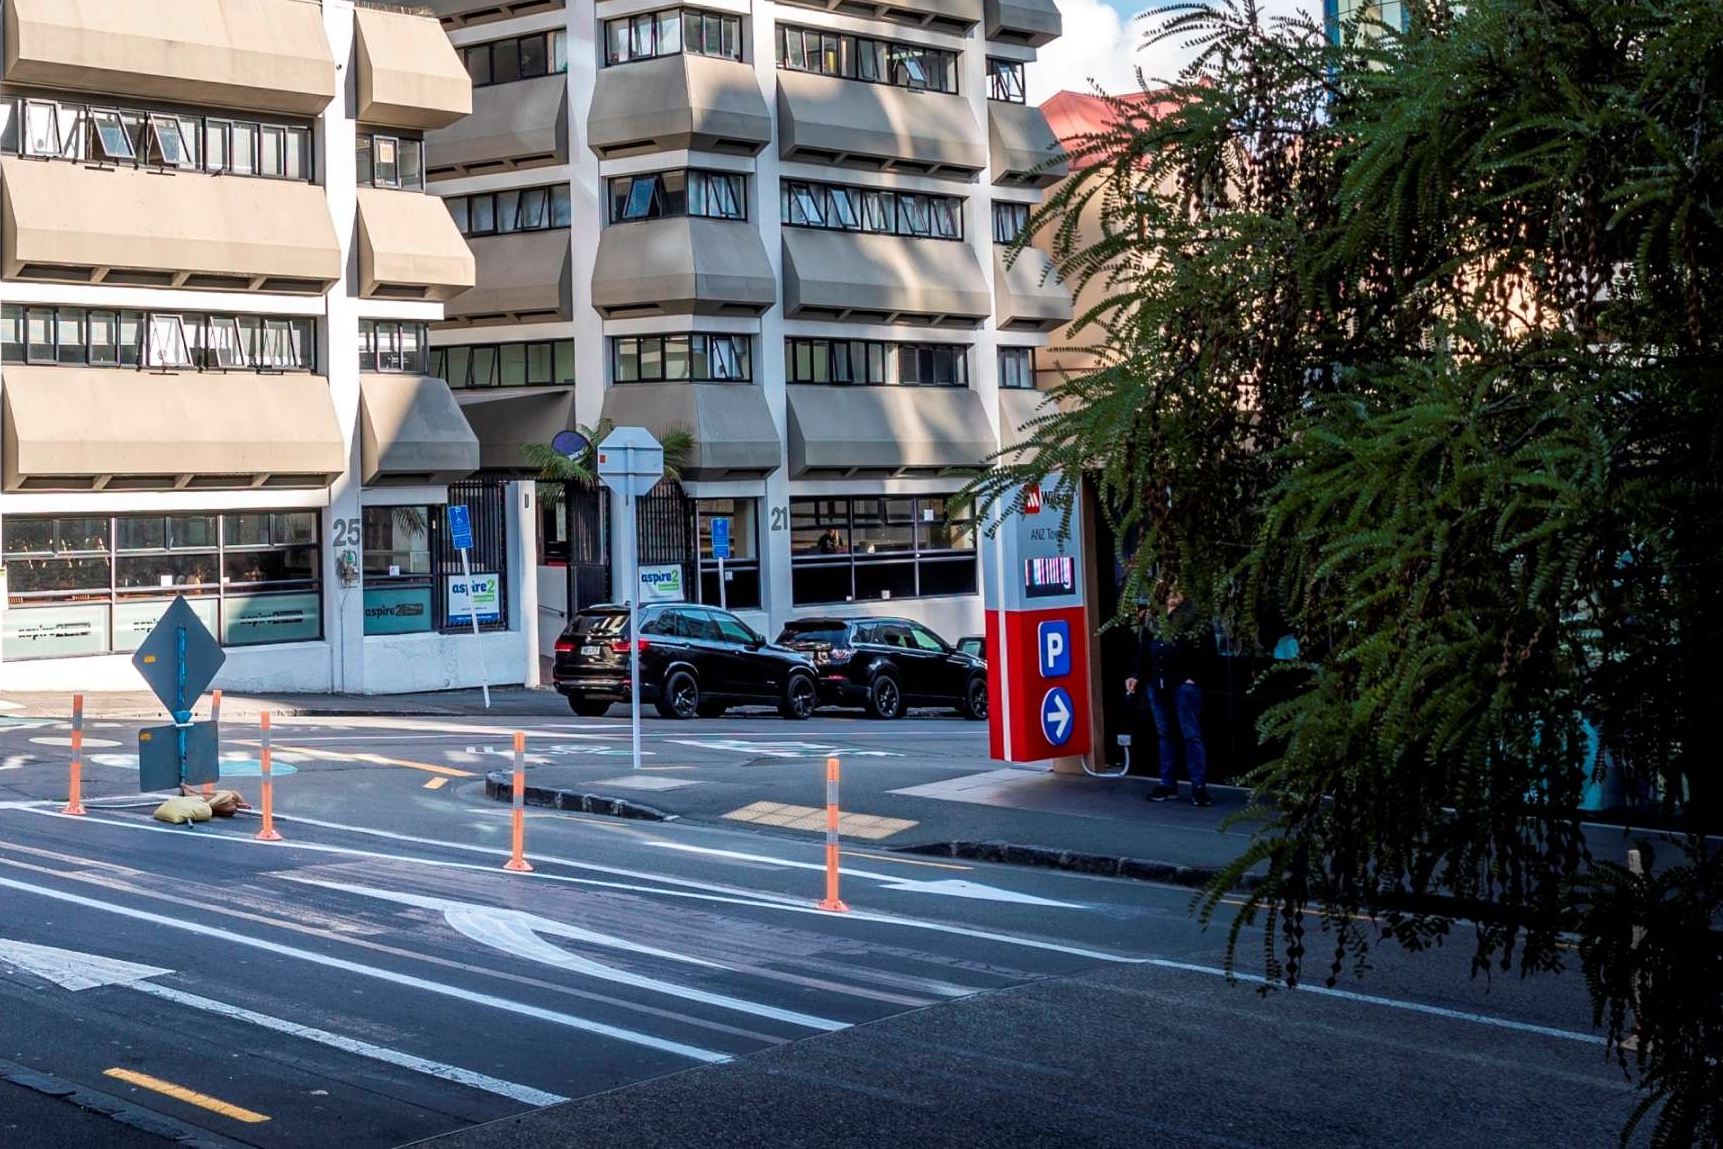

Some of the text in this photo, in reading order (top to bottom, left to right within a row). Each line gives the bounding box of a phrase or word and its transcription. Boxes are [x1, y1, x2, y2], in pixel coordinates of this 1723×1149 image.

[771, 507, 788, 531] 21
[333, 518, 360, 546] 25
[1030, 528, 1045, 540] ANZ
[641, 570, 679, 585] aspire2
[1047, 632, 1063, 668] P
